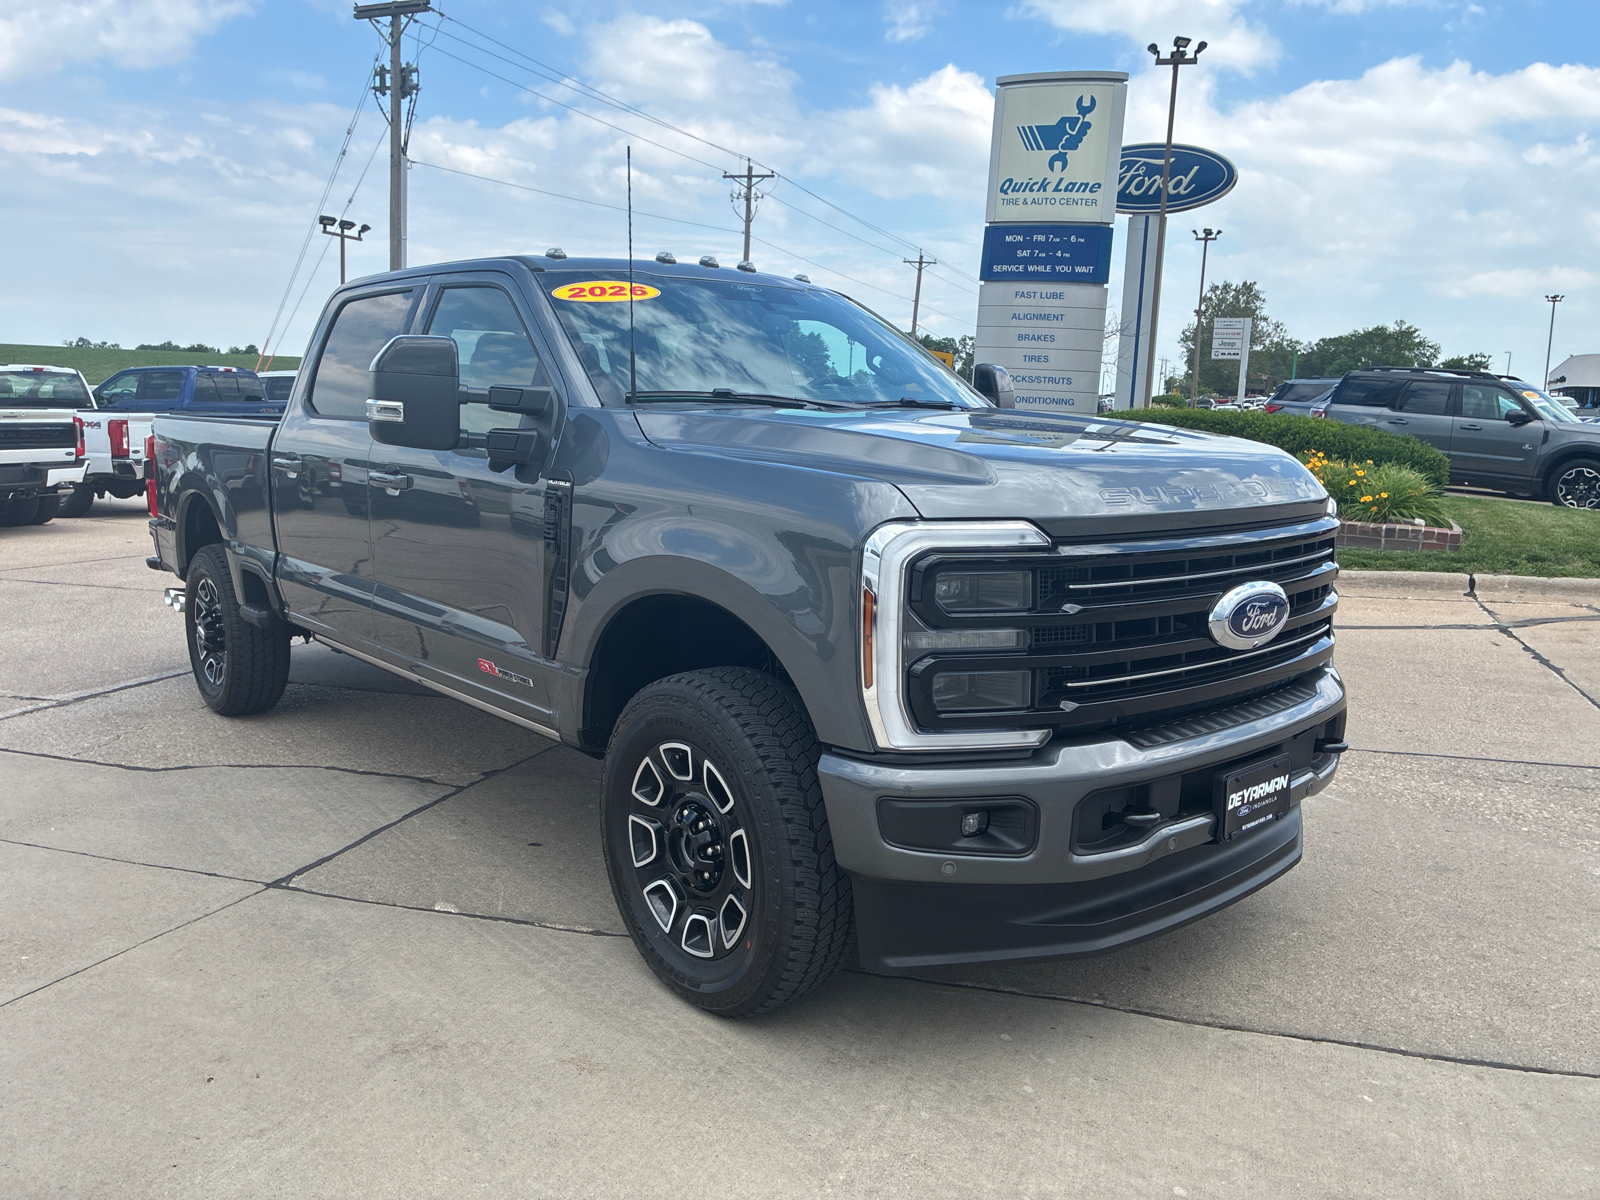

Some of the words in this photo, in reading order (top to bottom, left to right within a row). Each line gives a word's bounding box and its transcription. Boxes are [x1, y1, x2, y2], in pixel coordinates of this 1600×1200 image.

[1118, 157, 1200, 196] Ford
[999, 177, 1052, 195] Quick
[1052, 177, 1102, 194] Lane
[1001, 198, 1020, 206] TIRE
[1022, 198, 1028, 206] &
[1030, 198, 1057, 206] AUTO
[1058, 198, 1098, 206] CENTER
[1055, 265, 1072, 273] YOU
[567, 286, 649, 299] 2026
[1015, 291, 1038, 299] FAST
[1011, 313, 1065, 321] ALIGNMENT
[1017, 333, 1055, 342] BRAKES
[1023, 355, 1049, 363] TIRES
[1100, 481, 1243, 507] SUPER
[1249, 477, 1312, 498] DUTY
[1242, 601, 1278, 631] Ford
[1227, 774, 1289, 811] DEYARMAN
[1252, 795, 1278, 810] INDIANOLA
